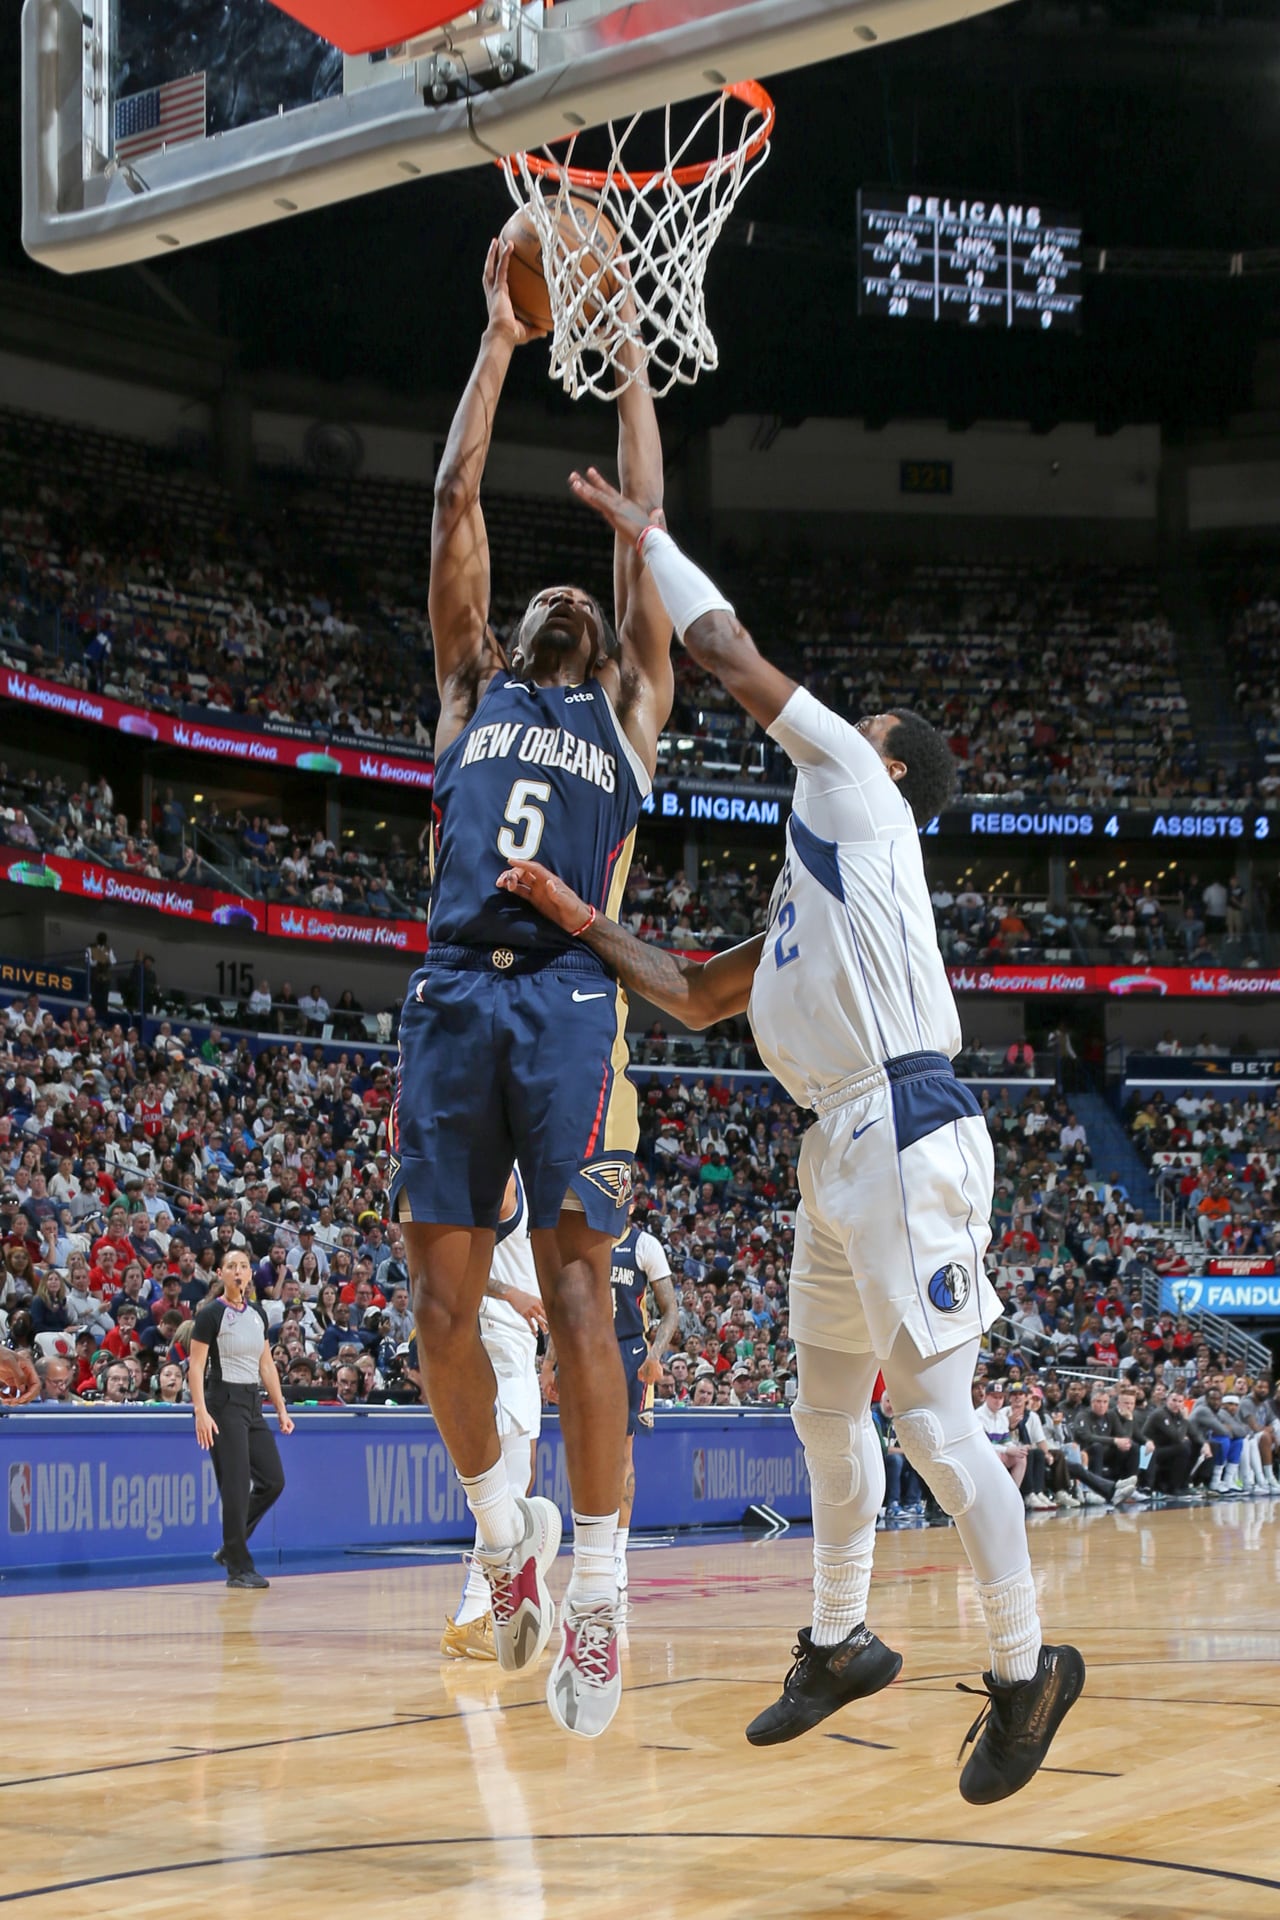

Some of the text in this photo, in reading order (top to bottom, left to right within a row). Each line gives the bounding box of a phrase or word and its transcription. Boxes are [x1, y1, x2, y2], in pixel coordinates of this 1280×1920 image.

[907, 195, 1041, 229] PELICANS
[889, 297, 908, 316] 20
[969, 303, 980, 322] 2
[460, 723, 616, 794] NEW ORLEANS
[497, 779, 551, 860] 5
[662, 793, 684, 816] B.
[690, 795, 779, 824] INGRAM
[971, 813, 1093, 835] REBOUNDS
[1104, 815, 1119, 837] 4
[1152, 816, 1244, 837] ASSISTS
[1255, 817, 1269, 838] 3
[105, 878, 164, 907] SMOOTHIE
[307, 918, 373, 942] SMOOTHIE
[775, 901, 800, 971] 2
[0, 964, 73, 991] RIVERS
[216, 960, 252, 996] 115
[979, 972, 1049, 990] SMOOTHIE
[708, 1448, 738, 1500] NBA
[740, 1447, 792, 1506] League
[36, 1462, 94, 1533] NBA
[98, 1462, 196, 1541] League
